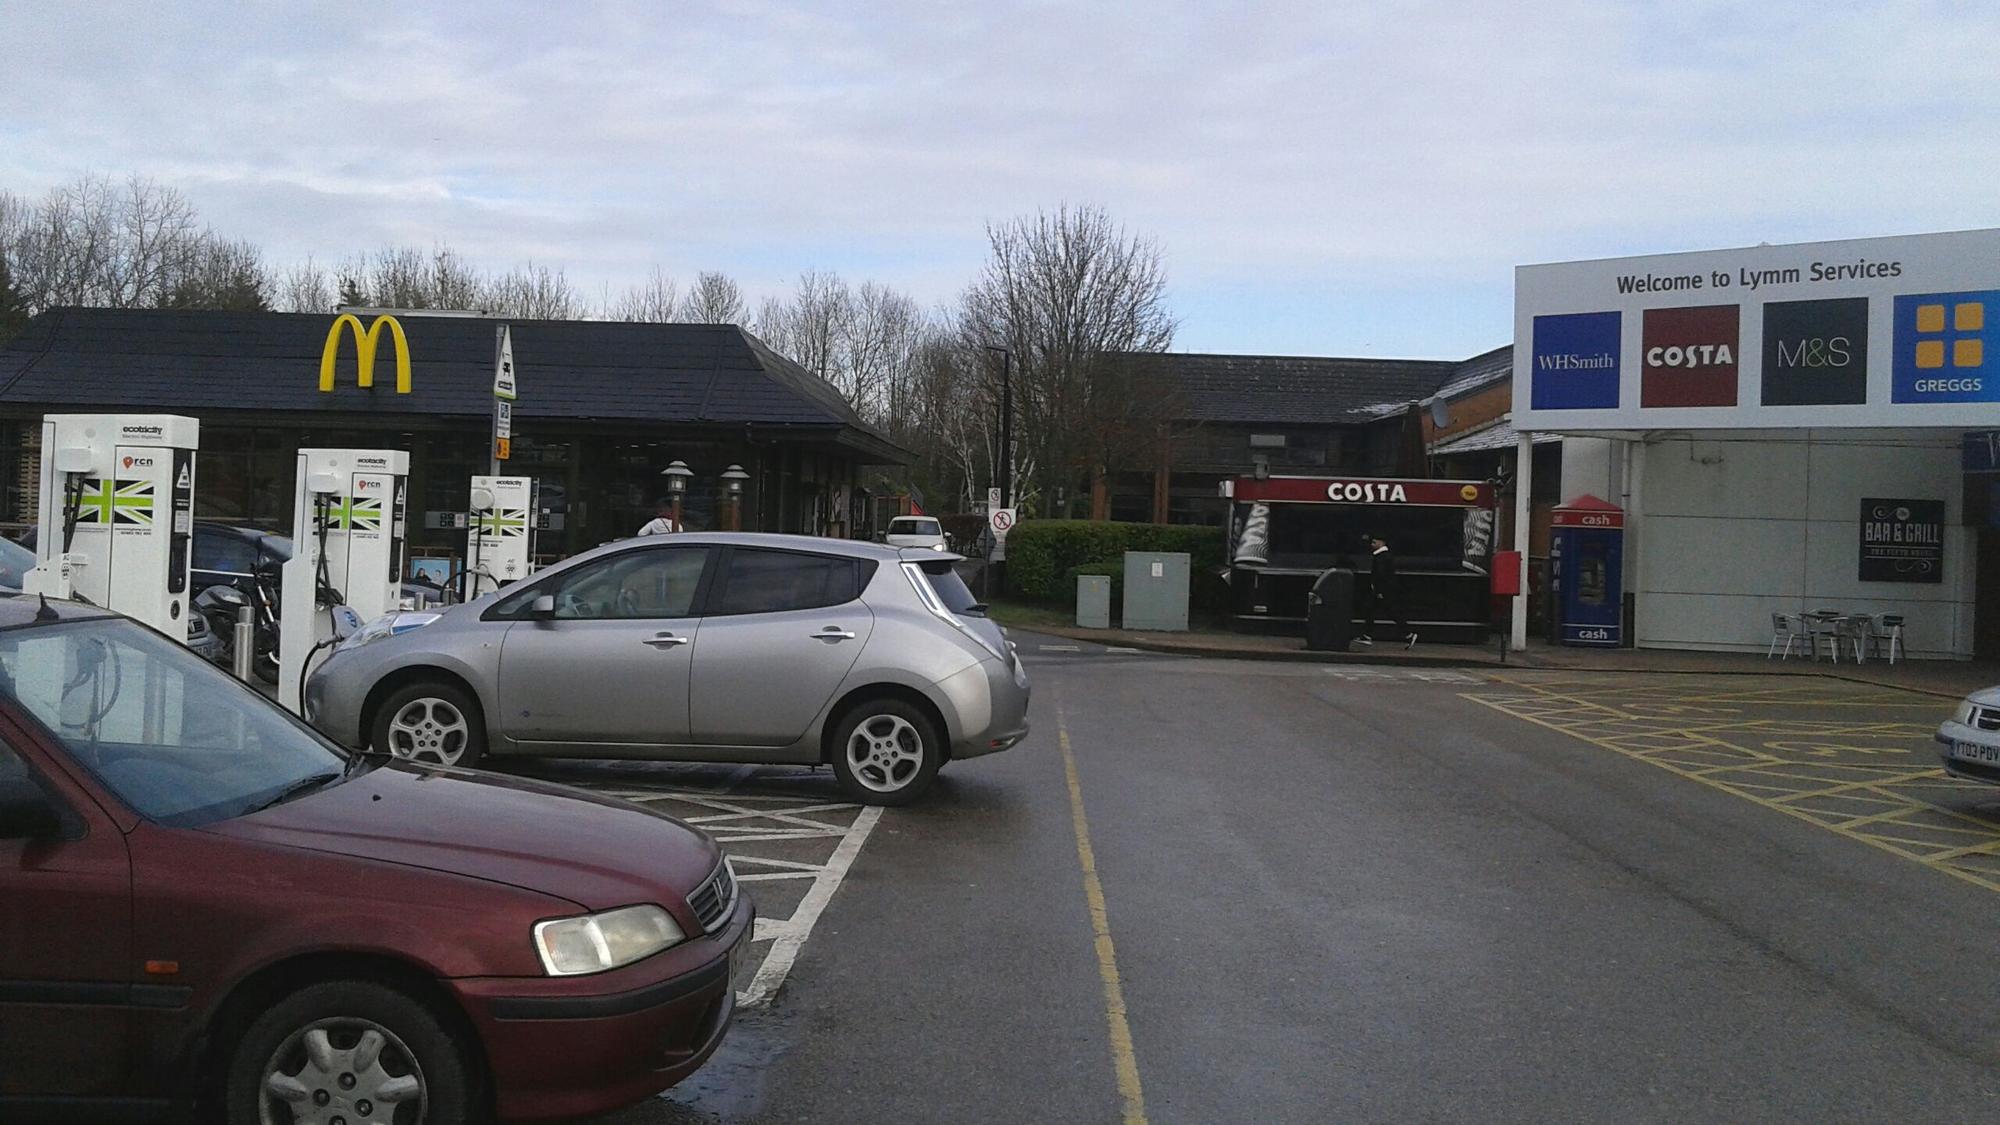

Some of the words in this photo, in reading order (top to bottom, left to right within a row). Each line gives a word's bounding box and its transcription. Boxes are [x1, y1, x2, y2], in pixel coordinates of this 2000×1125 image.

[1617, 273, 1703, 294] Welcome
[1711, 270, 1731, 288] to
[1739, 267, 1800, 291] Lymm
[1810, 258, 1901, 282] Services
[1647, 344, 1733, 368] COSTA
[1778, 336, 1850, 368] M&S
[1538, 353, 1613, 370] WHSmith
[1914, 378, 1982, 393] GREGGS
[122, 426, 163, 435] ecotricity
[134, 458, 153, 466] rcn
[1328, 482, 1407, 503] COSTA
[1582, 515, 1610, 525] cash
[1865, 522, 1890, 542] BAR
[1894, 523, 1902, 542] &
[1905, 523, 1939, 543] GRILL
[1579, 628, 1607, 639] cash
